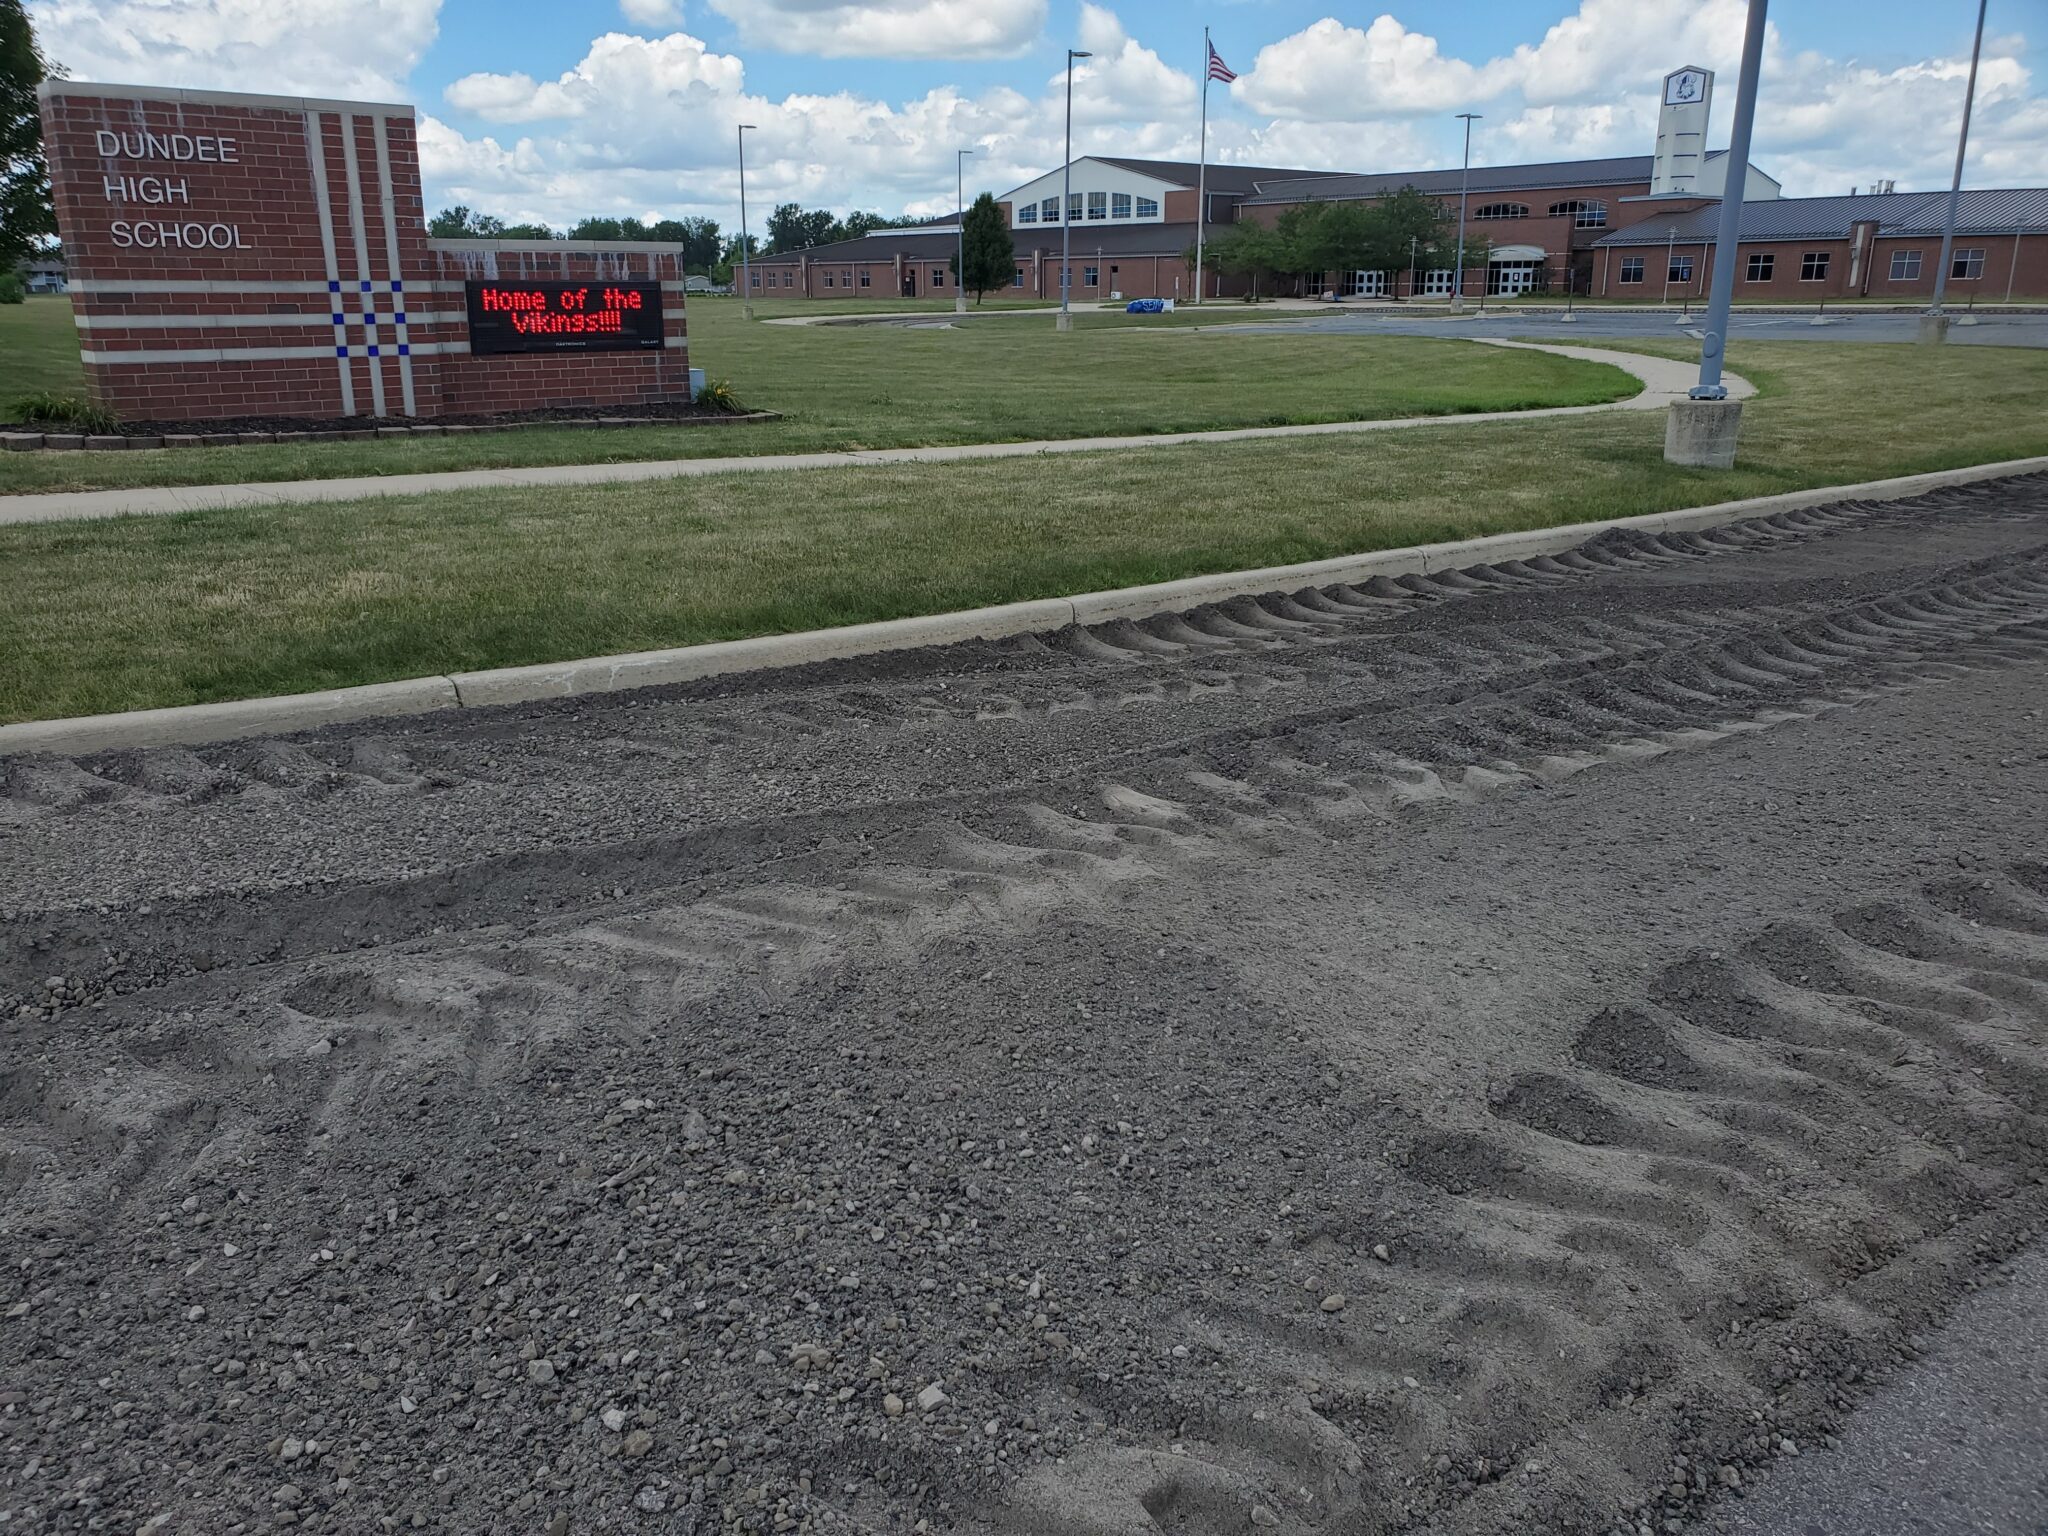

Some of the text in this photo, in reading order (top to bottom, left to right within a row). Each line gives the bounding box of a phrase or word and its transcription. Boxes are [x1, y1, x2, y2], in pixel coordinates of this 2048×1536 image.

[96, 130, 239, 163] DUNDEE
[103, 176, 188, 204] HIGH
[111, 221, 252, 249] SCHOOL
[481, 288, 642, 311] Home of the
[511, 310, 622, 334] Vikings!!!!
